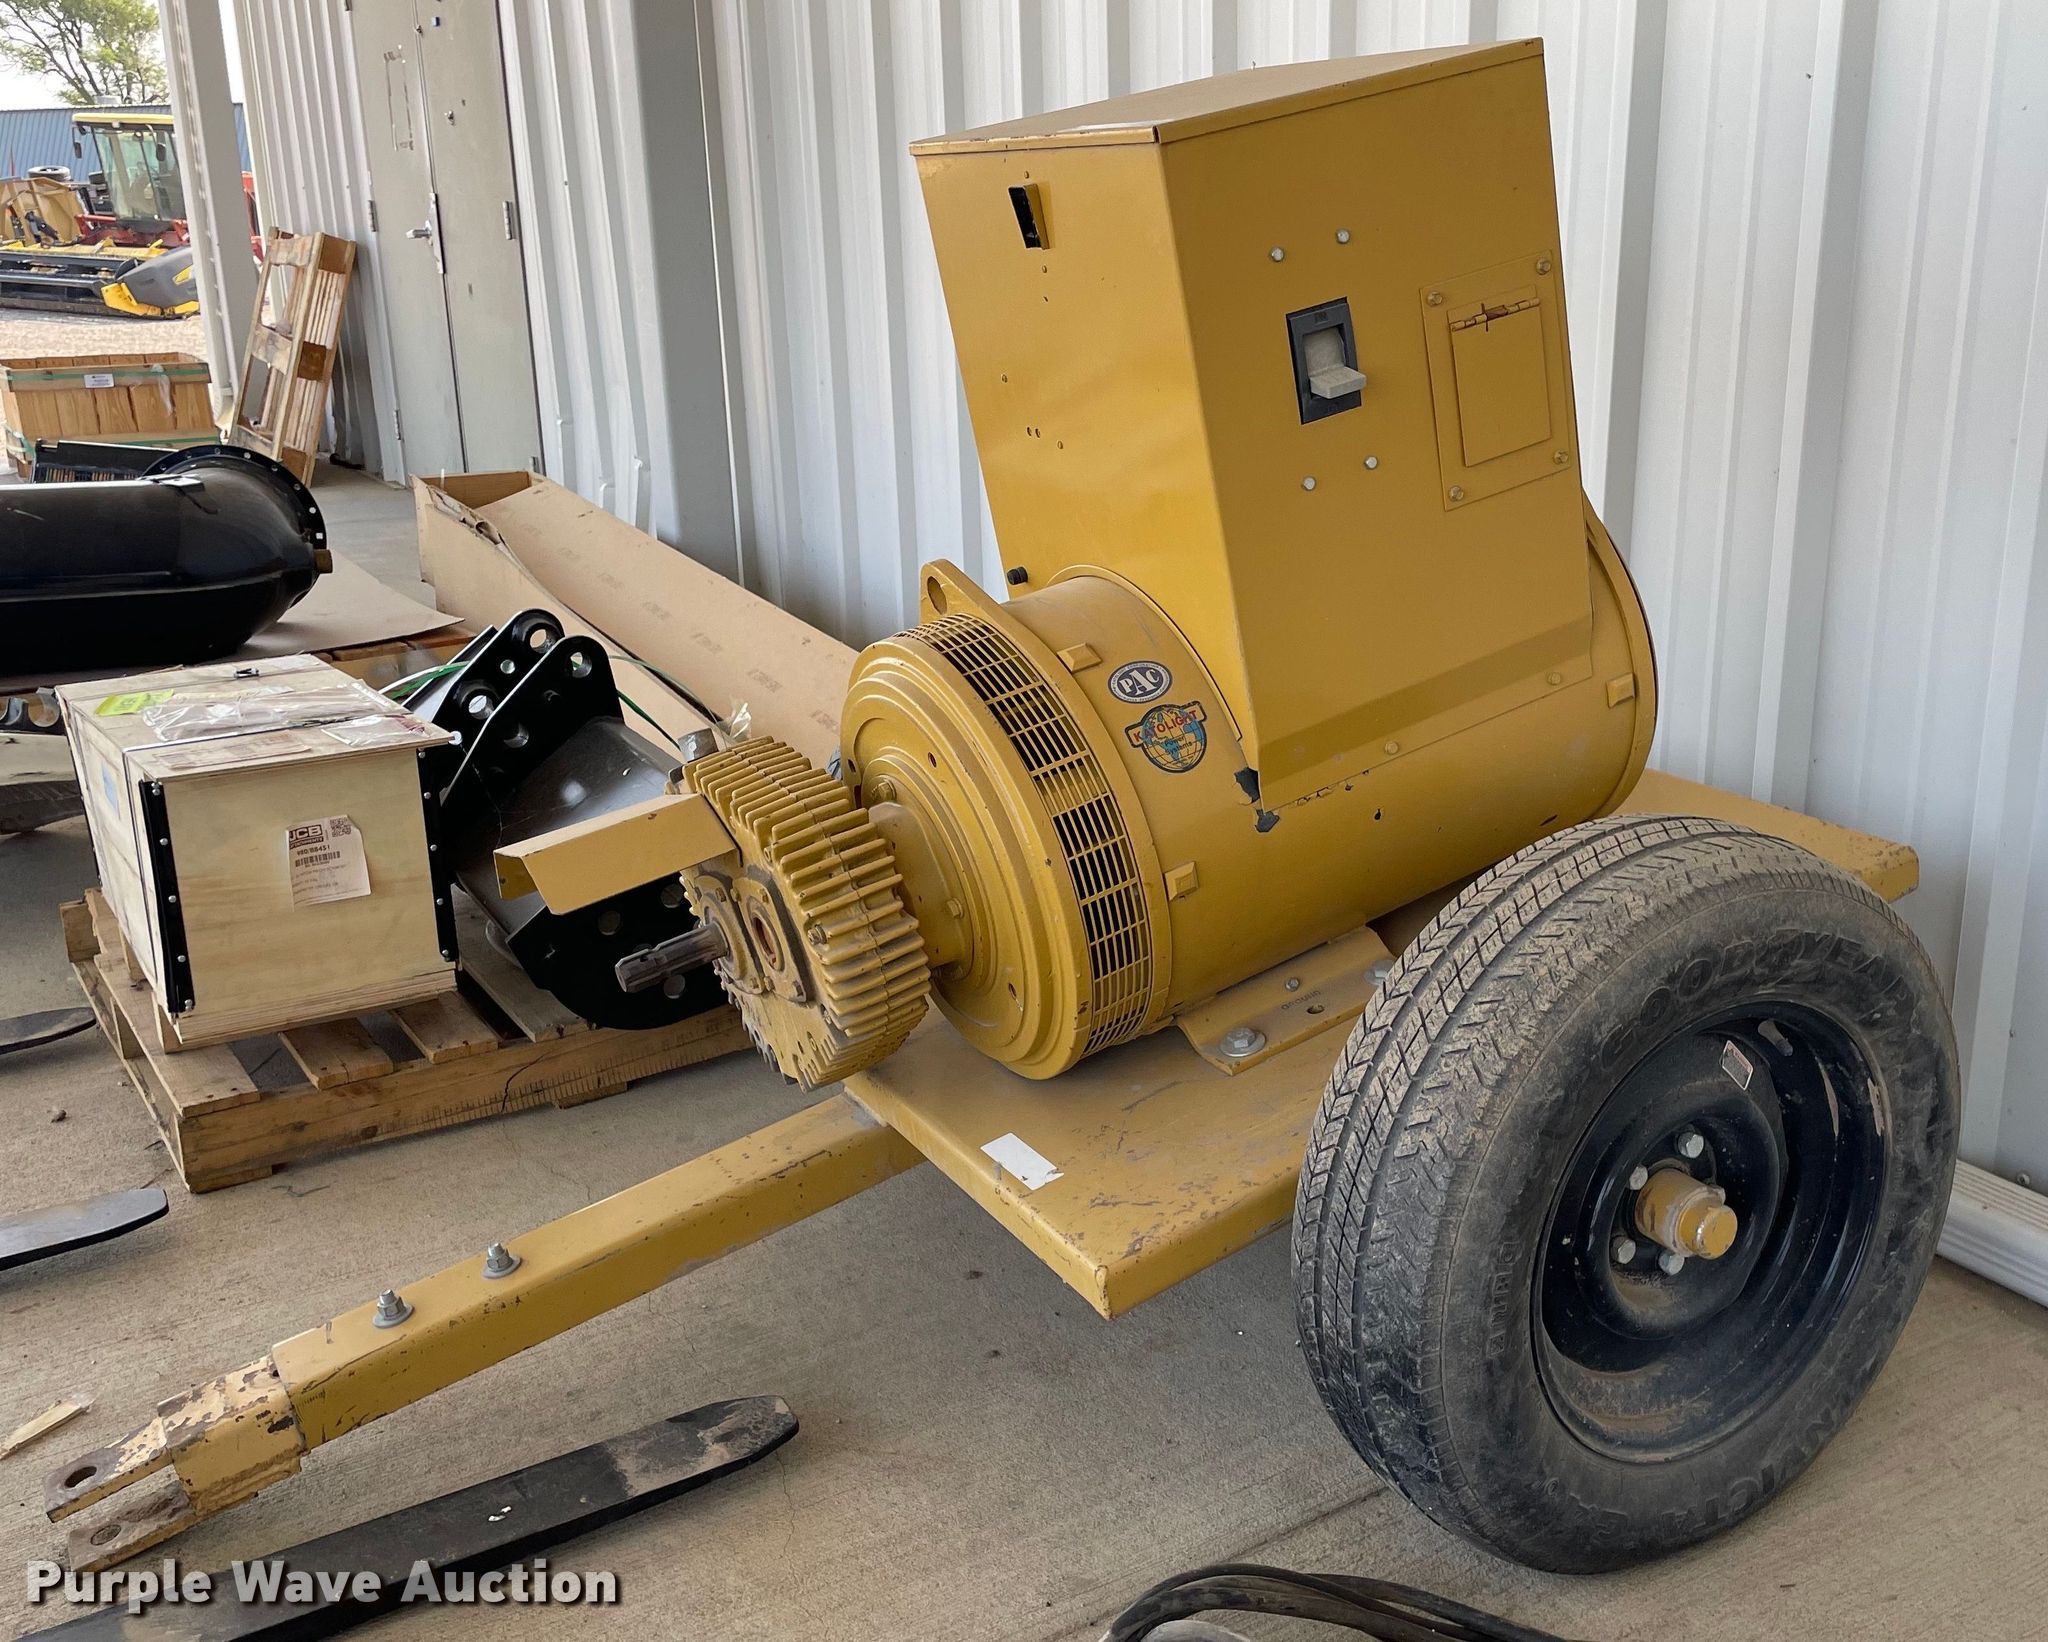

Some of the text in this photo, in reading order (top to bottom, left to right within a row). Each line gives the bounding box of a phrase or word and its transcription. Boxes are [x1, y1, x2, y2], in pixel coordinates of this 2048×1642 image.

[1118, 669, 1160, 696] PAC
[1133, 710, 1198, 742] KATOLIGHT
[289, 825, 322, 840] JCB
